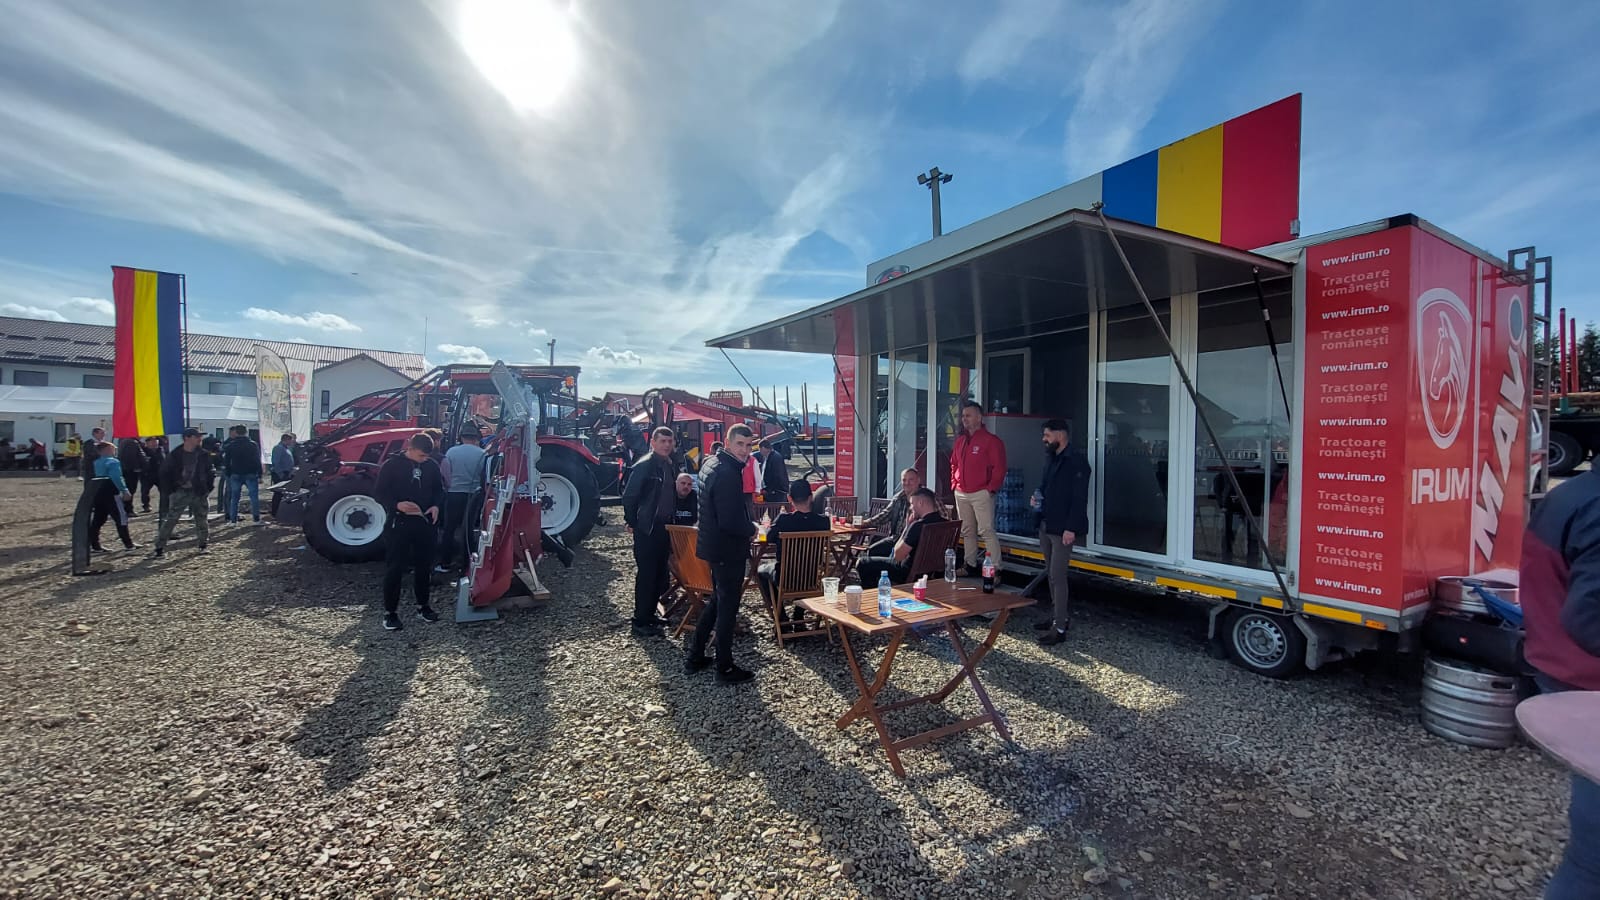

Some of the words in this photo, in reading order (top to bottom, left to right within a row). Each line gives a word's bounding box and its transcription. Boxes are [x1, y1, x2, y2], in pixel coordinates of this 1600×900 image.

[1322, 248, 1390, 267] www.irum.ro
[1322, 268, 1390, 286] Tractoare
[1322, 304, 1390, 320] www.irum.ro
[1321, 325, 1389, 340] Tractoare
[1320, 362, 1388, 374] www.irum.ro
[1320, 382, 1388, 394] Tractoare
[1320, 416, 1387, 426] www.irum.ro
[1320, 437, 1386, 448] Tractoare
[1474, 328, 1527, 563] MAV
[1318, 472, 1386, 482] www.irum.ro
[1411, 467, 1470, 505] IRUM
[1318, 490, 1384, 504] Tractoare
[1316, 524, 1384, 539] www.irum.ro
[1316, 543, 1383, 560] Tractoare
[1315, 577, 1382, 596] www.irum.ro
